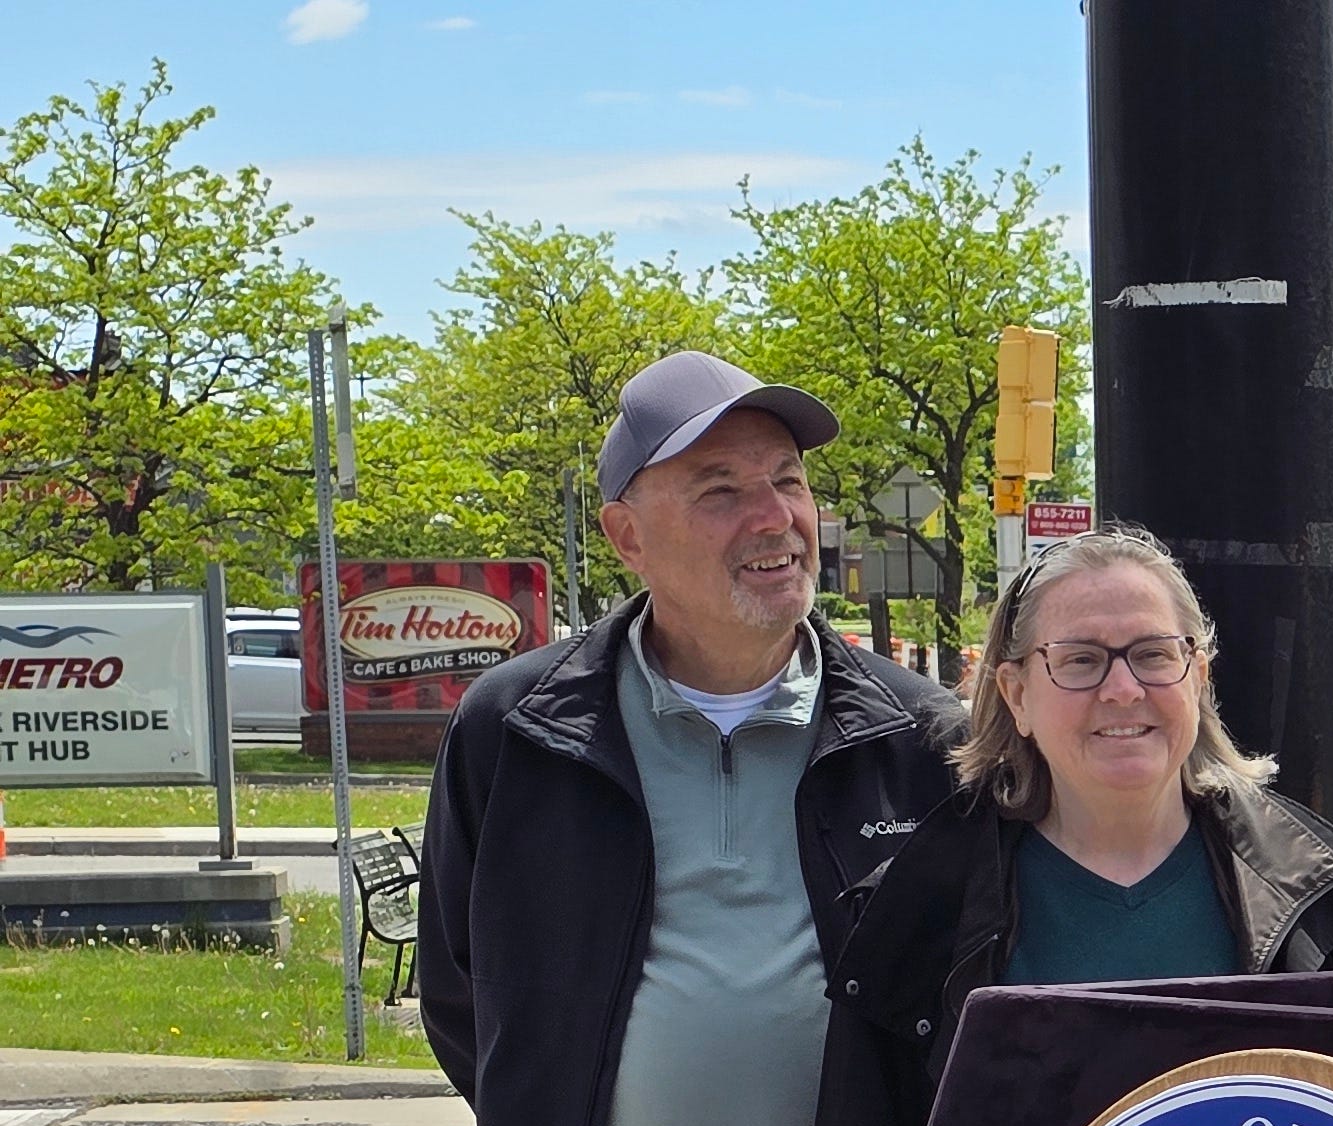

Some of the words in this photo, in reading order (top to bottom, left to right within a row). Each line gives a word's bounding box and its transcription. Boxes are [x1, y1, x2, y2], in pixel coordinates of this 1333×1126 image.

[339, 605, 396, 641] Tim
[400, 605, 518, 641] Hortons
[353, 661, 396, 676] CAFE
[410, 654, 454, 671] BAKE
[458, 652, 502, 667] SHOP
[13, 710, 169, 733] RIVERSIDE
[29, 740, 91, 761] HUB
